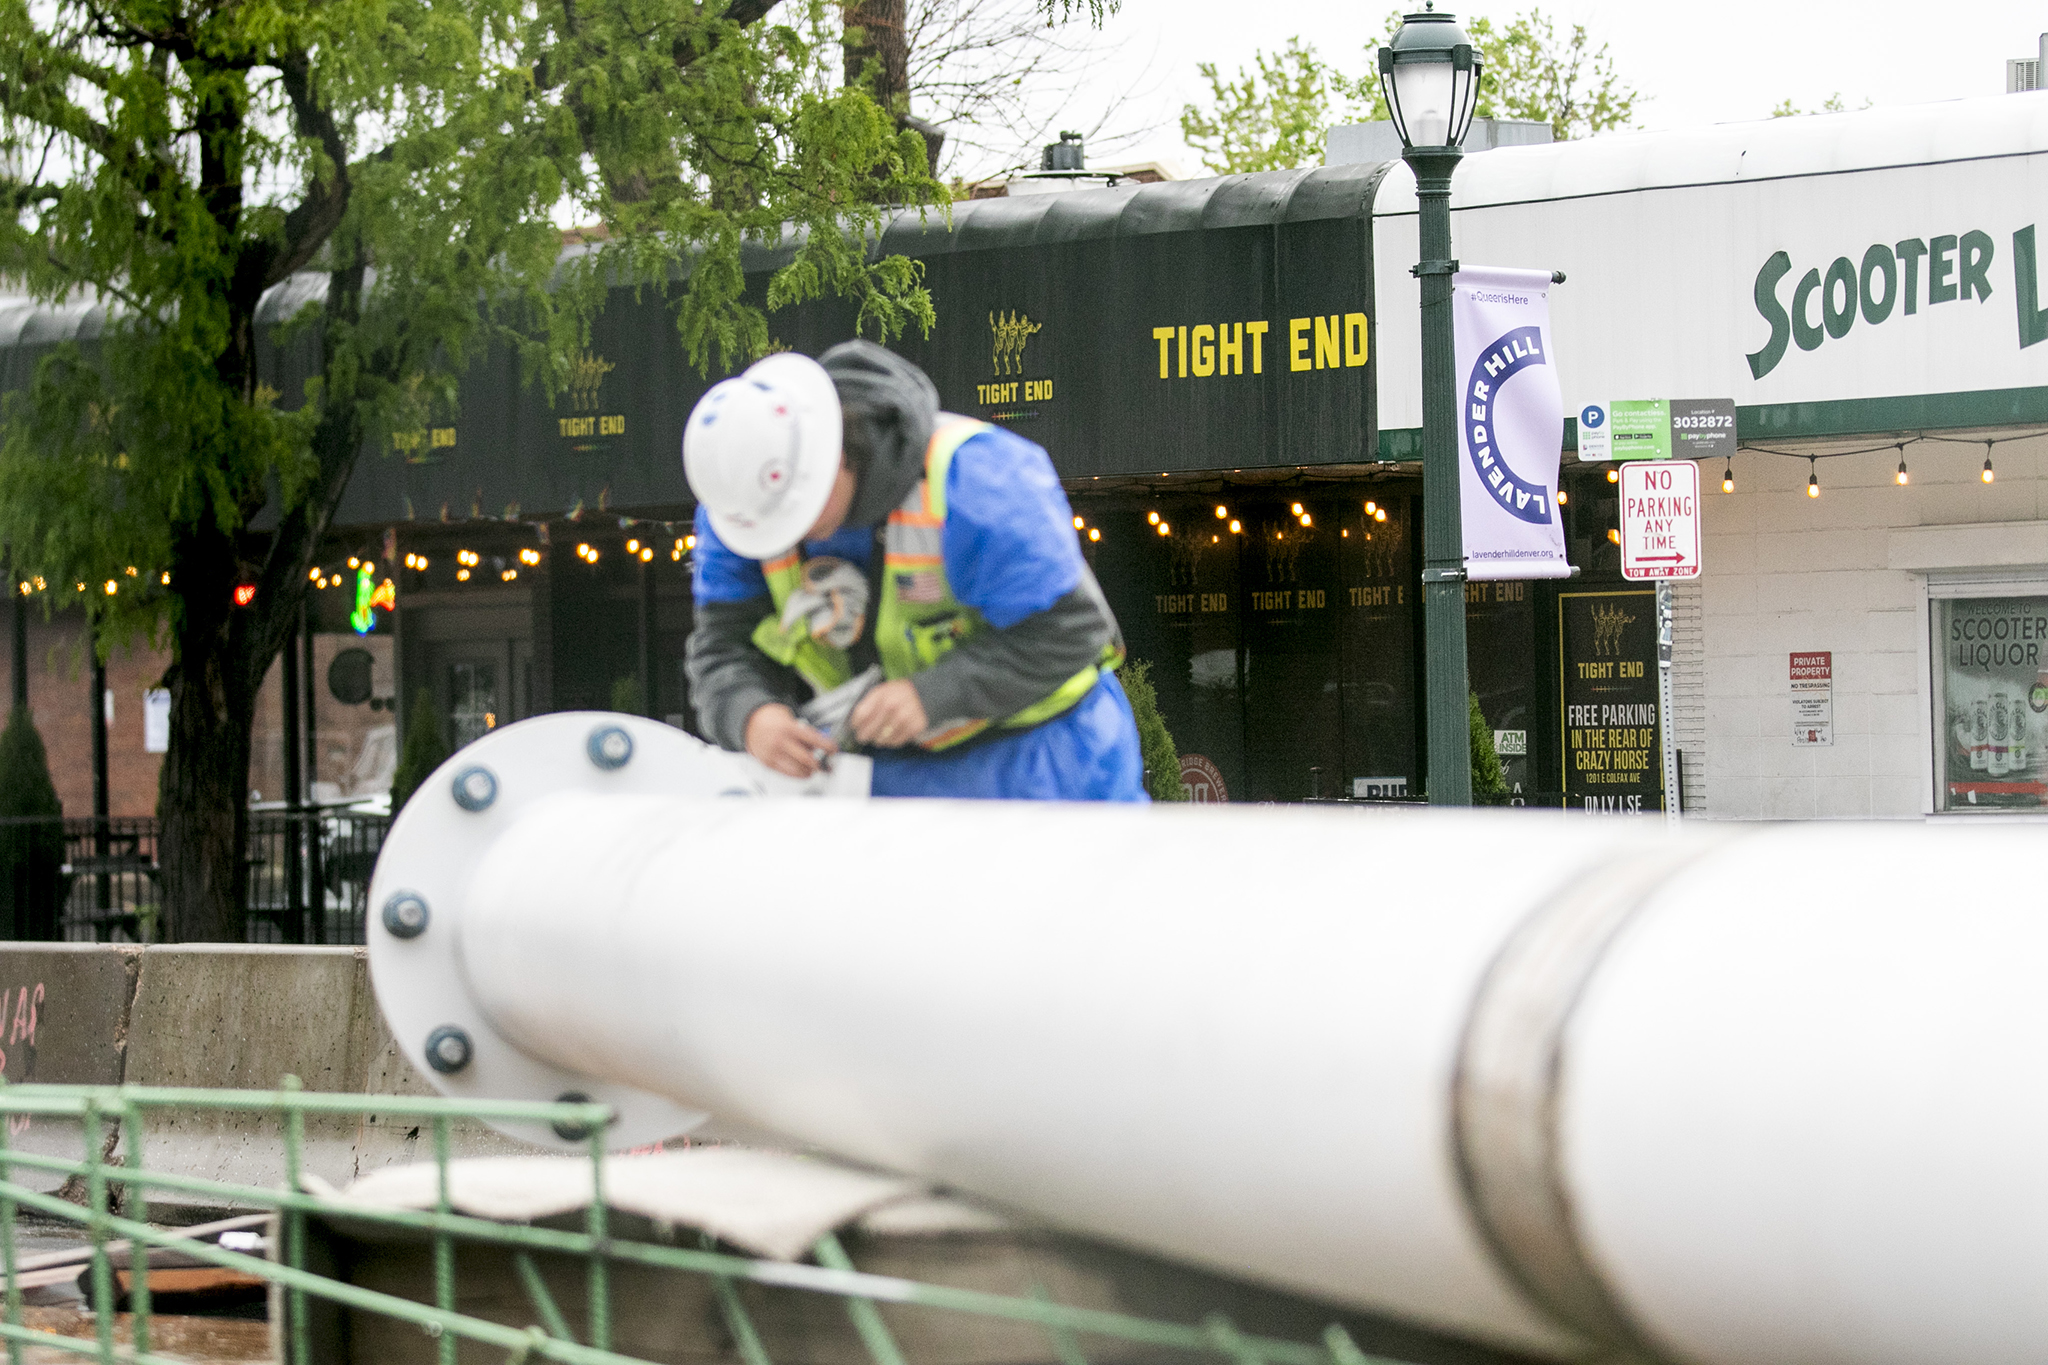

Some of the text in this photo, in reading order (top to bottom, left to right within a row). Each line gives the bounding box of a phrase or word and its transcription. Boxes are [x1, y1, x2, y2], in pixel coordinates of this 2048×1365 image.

[1745, 229, 1994, 380] SCOOTER
[1153, 312, 1368, 379] TIGHT END
[977, 380, 1053, 405] TIGHT END
[558, 415, 625, 437] TIGHT END
[1472, 336, 1545, 514] LAVENDER HILL
[1673, 415, 1733, 428] 3032872
[1688, 432, 1727, 441] paybyphone
[1644, 470, 1672, 491] NO
[1628, 496, 1692, 518] PARKING
[1644, 519, 1673, 533] ANY
[1643, 535, 1676, 550] TIME
[1472, 549, 1554, 559] lavenderhilldenver.org
[1629, 567, 1694, 577] TOW AWAY ZONE
[1251, 590, 1326, 610] TIGHT END
[1349, 586, 1391, 606] TIGHT
[1496, 582, 1524, 602] END
[1155, 593, 1227, 613] TIGHT END
[1968, 603, 2031, 615] WELCOME TO
[1952, 617, 2048, 641] SCOOTER
[1793, 657, 1825, 666] PRIVATE
[1960, 643, 2038, 672] LIQUOR
[1578, 661, 1644, 679] TIGHT END
[1791, 667, 1830, 676] PROPERTY
[1568, 704, 1656, 726] FREE PARKING
[1499, 743, 1527, 753] INSIDE
[1501, 732, 1525, 744] ATM
[1571, 728, 1653, 749] IN THE REAR OF
[1576, 750, 1649, 771] CRAZY HORSE
[1586, 773, 1641, 784] 1201 E COLFAX AVE
